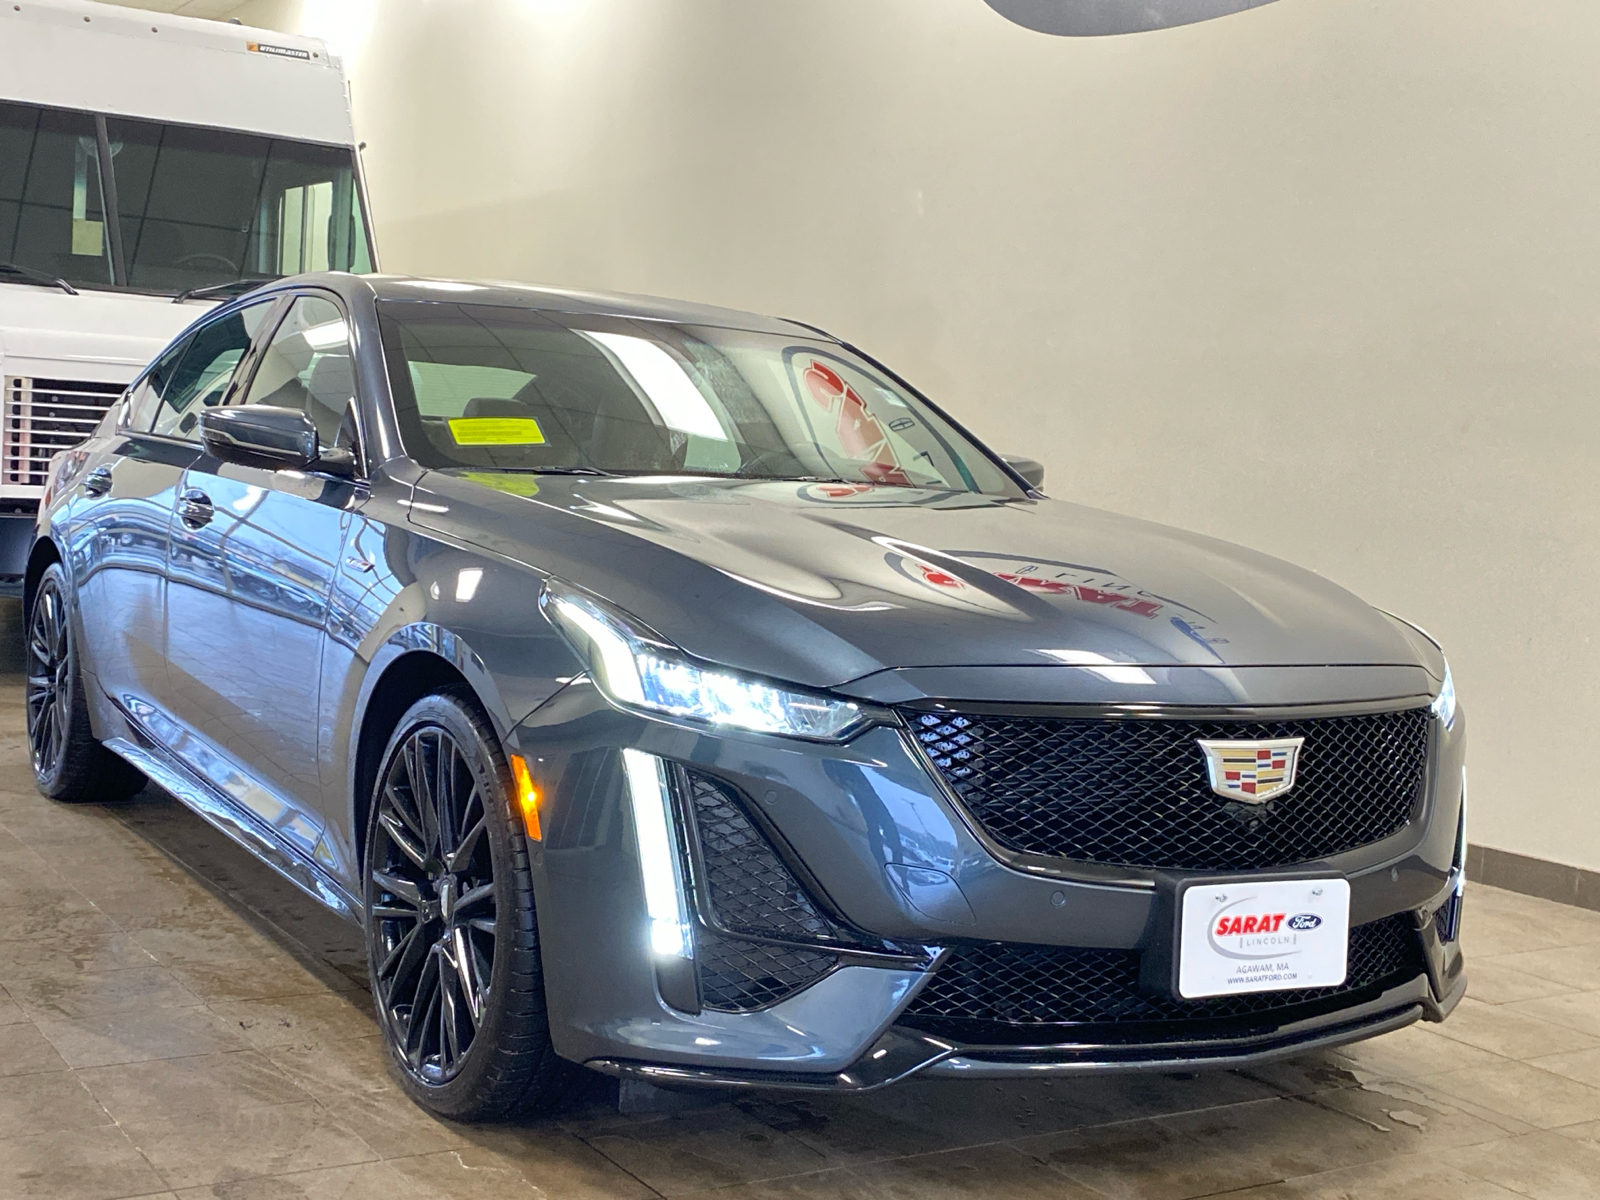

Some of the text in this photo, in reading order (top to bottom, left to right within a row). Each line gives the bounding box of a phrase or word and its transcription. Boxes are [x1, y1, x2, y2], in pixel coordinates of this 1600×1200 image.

[260, 45, 308, 58] UTILIMASTER
[1216, 913, 1317, 936] SARAT Ford
[1246, 936, 1290, 947] LINCOLN
[1236, 962, 1289, 974] AGAWAM, MA
[1227, 973, 1298, 984] WWW.SARATFORD.COM
